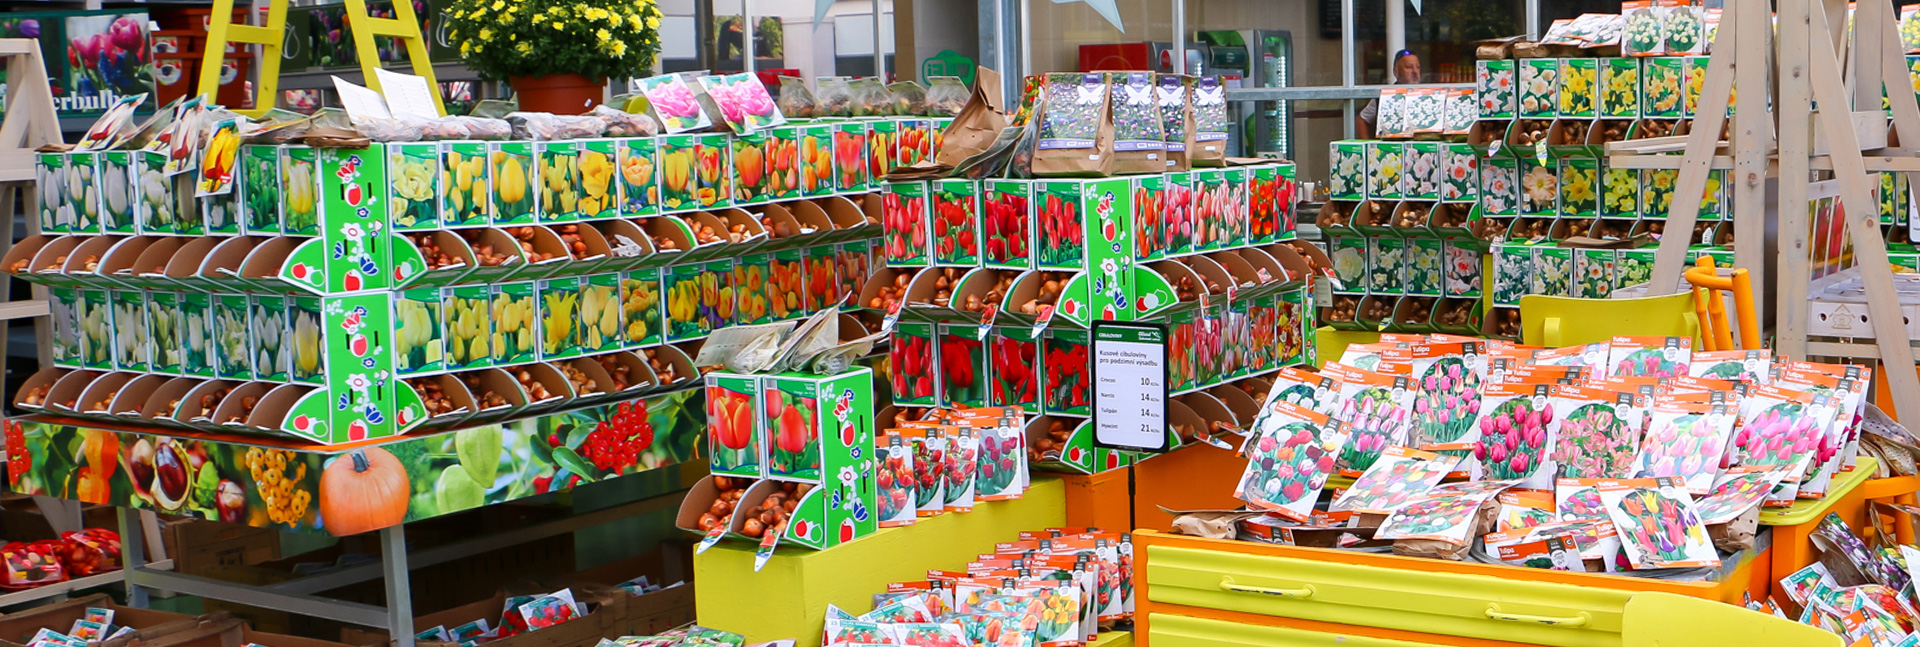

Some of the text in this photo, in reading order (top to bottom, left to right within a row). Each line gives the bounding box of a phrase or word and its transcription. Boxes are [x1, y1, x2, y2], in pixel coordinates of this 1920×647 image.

[1413, 345, 1430, 353] Tulipa
[1120, 351, 1147, 359] cibuloviny
[1346, 371, 1363, 379] Tulipa
[1786, 371, 1805, 379] Tulipa
[1141, 377, 1150, 386] 10
[1678, 376, 1697, 384] Tulipa
[1560, 385, 1581, 394] Tulipa
[1760, 385, 1779, 393] Tulipa
[1141, 393, 1150, 401] 14
[1141, 408, 1150, 417] 14
[1141, 424, 1150, 432] 21
